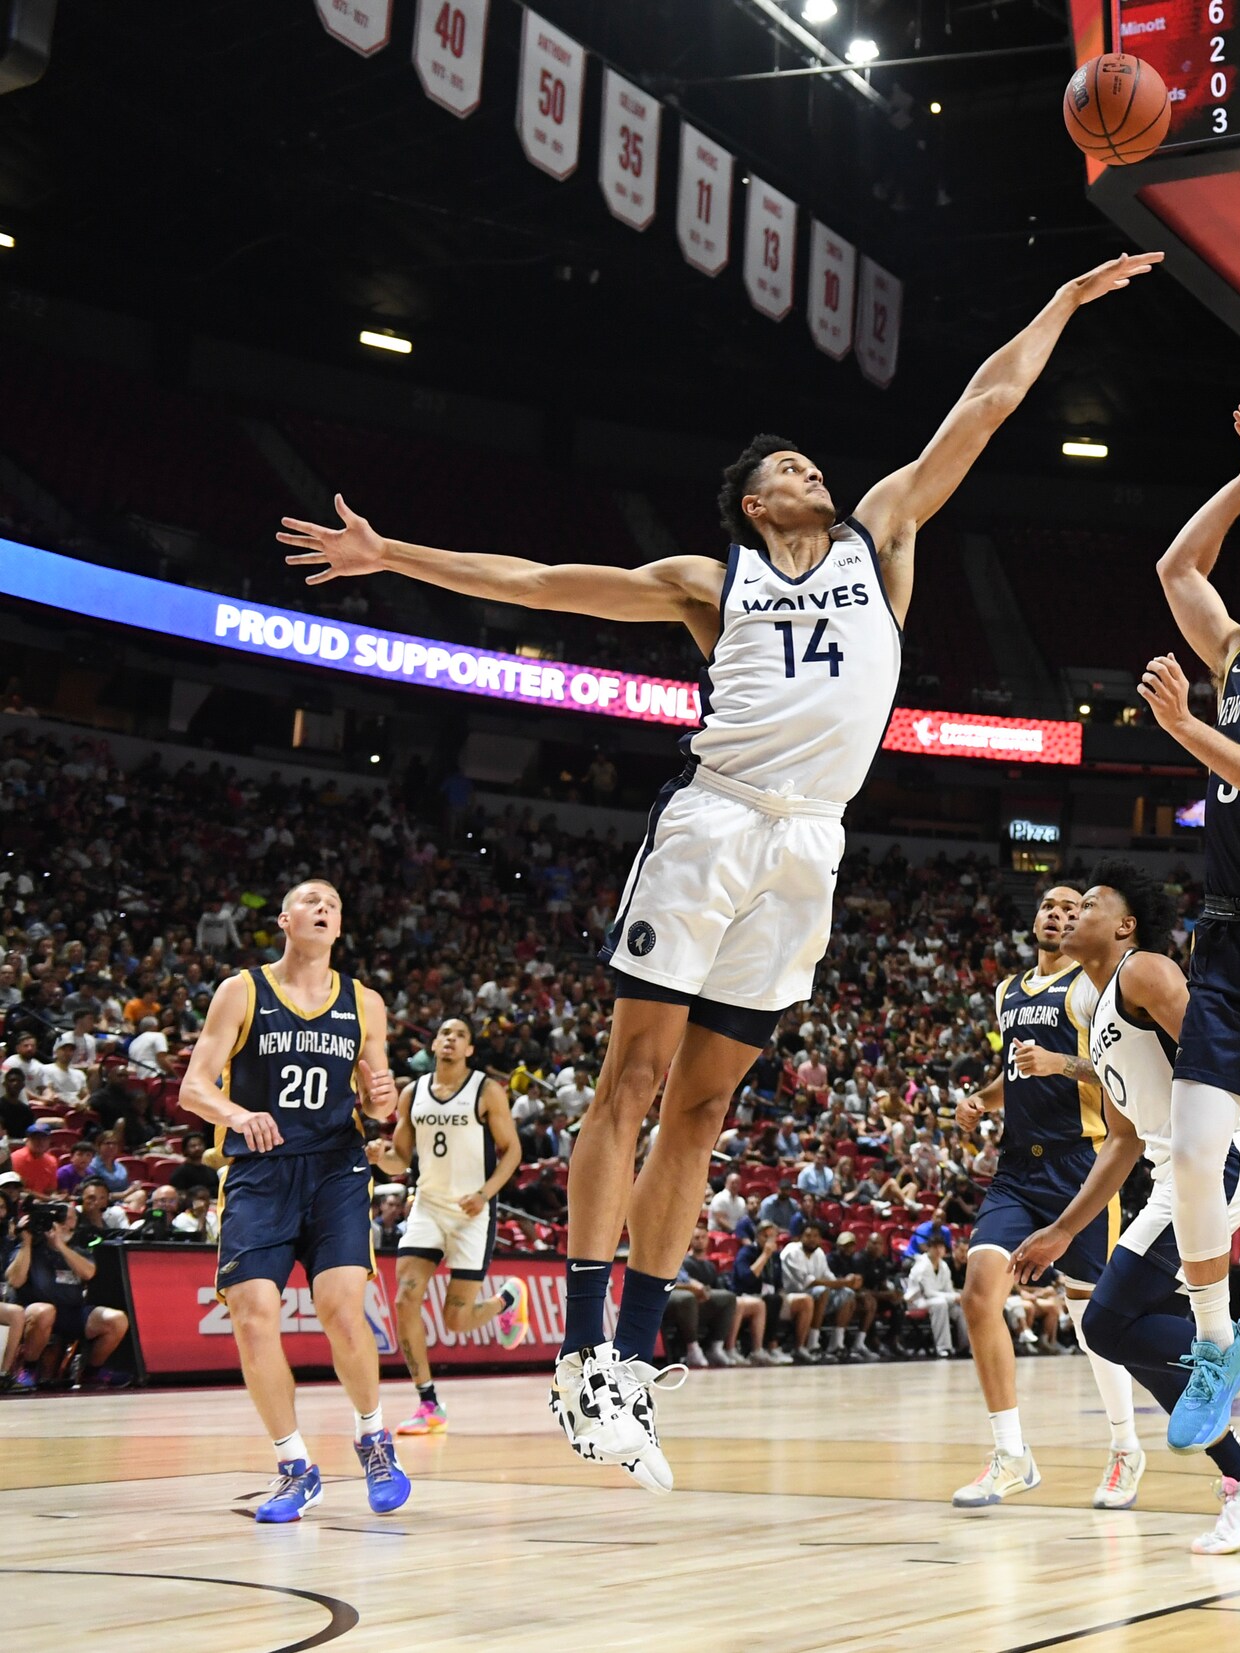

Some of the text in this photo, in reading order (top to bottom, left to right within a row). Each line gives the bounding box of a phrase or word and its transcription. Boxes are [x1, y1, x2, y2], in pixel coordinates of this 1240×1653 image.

[435, 1, 465, 58] 40
[1119, 16, 1167, 37] Minott
[1208, 0, 1224, 24] 6
[1209, 36, 1225, 63] 2
[539, 68, 566, 125] 50
[1211, 72, 1227, 98] 0
[1212, 108, 1228, 133] 3
[618, 125, 643, 178] 35
[697, 178, 712, 224] 11
[763, 227, 779, 272] 13
[824, 268, 840, 313] 10
[873, 302, 887, 343] 12
[215, 603, 349, 660] PROUD
[354, 634, 566, 700] SUPPORTER
[570, 672, 619, 707] OF
[775, 618, 844, 678] 14
[330, 1010, 356, 1020] ibotta
[1017, 1005, 1060, 1028] ORLEANS
[259, 1030, 356, 1061] NEW ORLEANS
[278, 1064, 329, 1110] 20
[414, 1114, 469, 1126] WOLVES
[433, 1131, 448, 1158] 8
